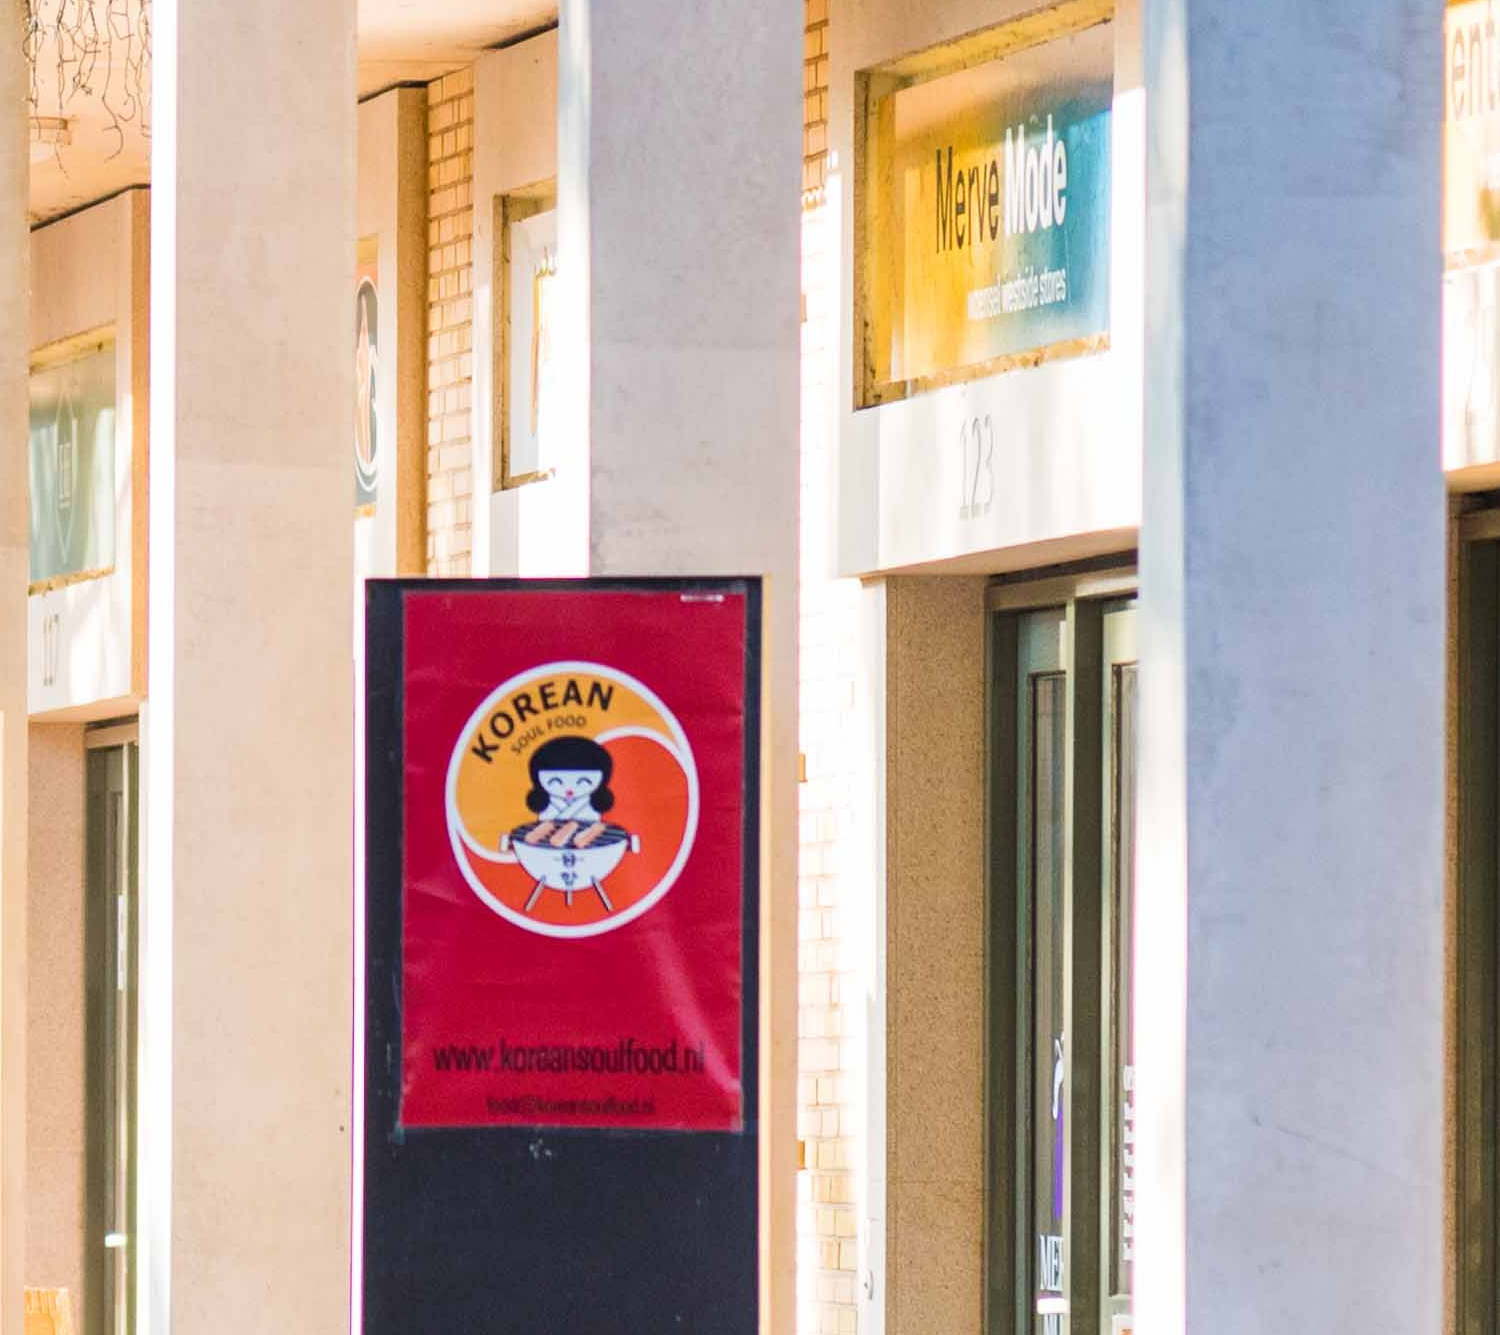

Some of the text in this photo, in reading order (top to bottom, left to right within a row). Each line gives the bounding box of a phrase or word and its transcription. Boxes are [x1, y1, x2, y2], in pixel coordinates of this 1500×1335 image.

[936, 113, 1067, 254] Merve Mode
[1040, 265, 1067, 306] stores
[472, 678, 615, 763] KOREAN
[511, 714, 587, 756] SOUL FOOD
[433, 1037, 705, 1074] www.koreansoulfood.nl
